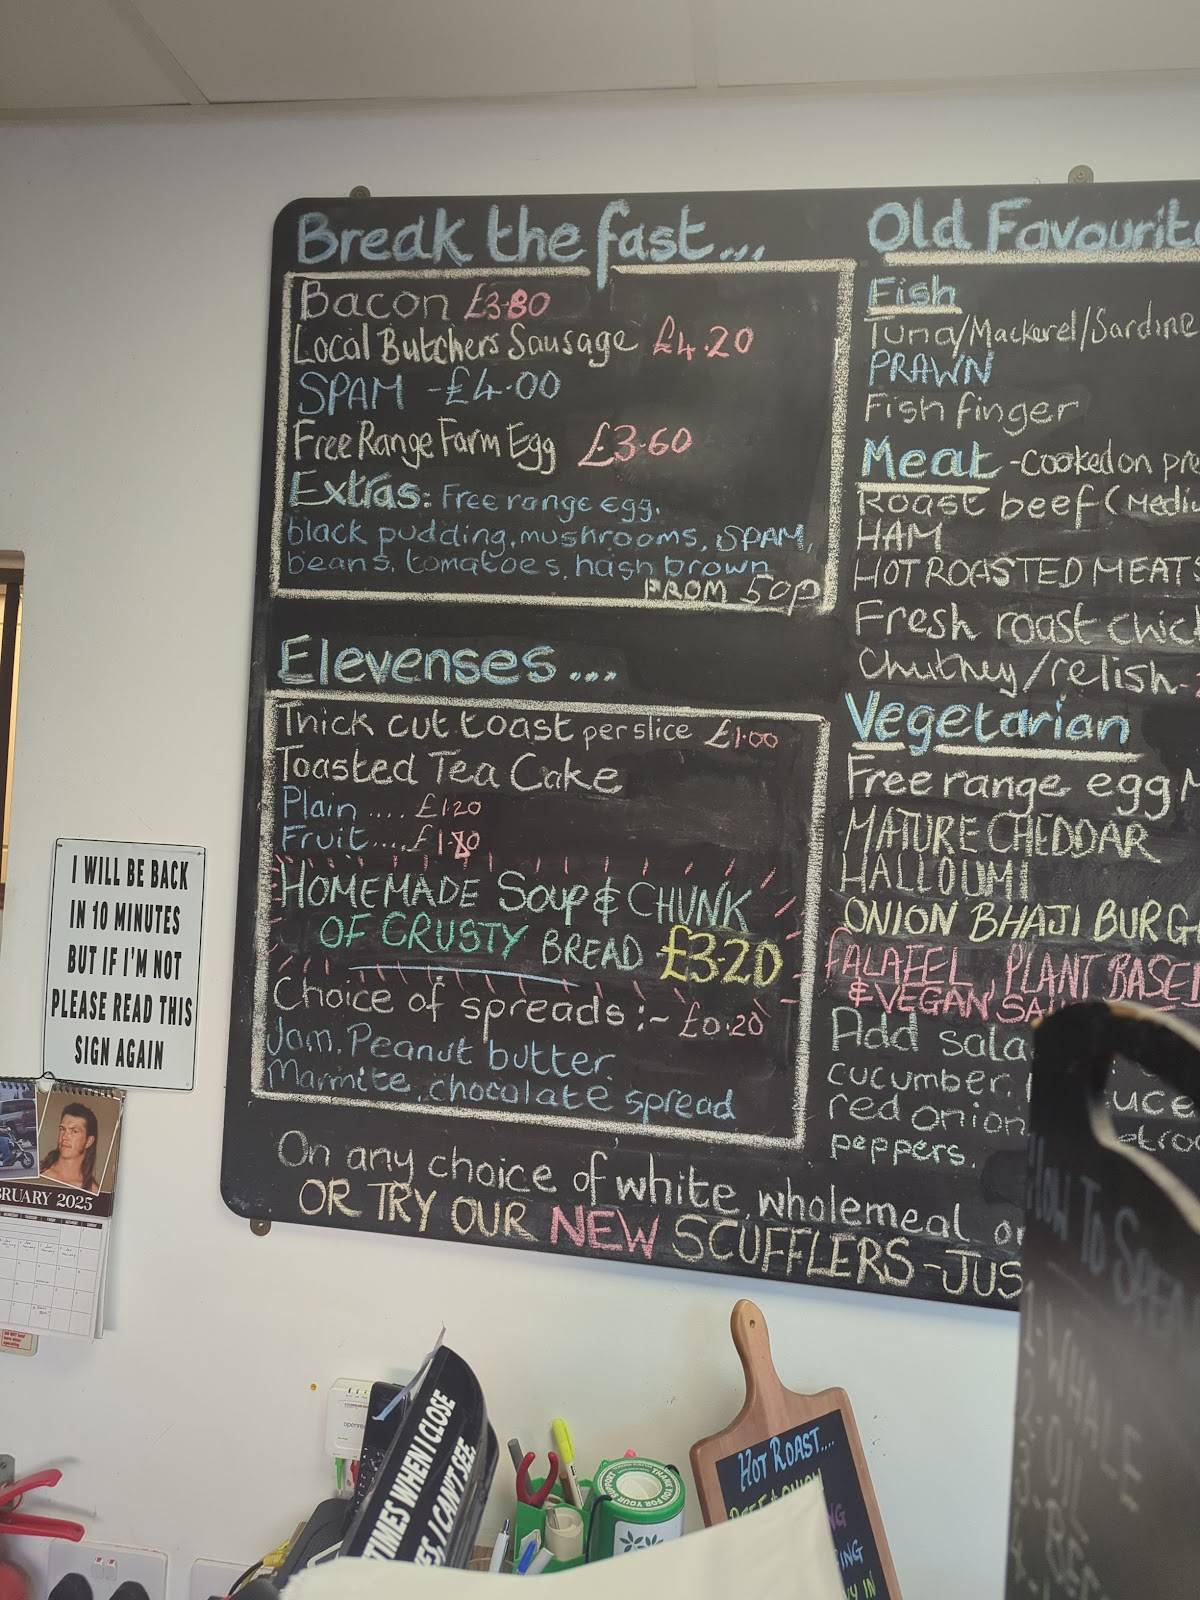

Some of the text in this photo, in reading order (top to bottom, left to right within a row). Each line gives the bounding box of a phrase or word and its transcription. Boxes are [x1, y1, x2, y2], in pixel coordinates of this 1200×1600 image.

[299, 211, 473, 267] Break
[488, 204, 588, 264] the
[867, 197, 972, 252] Old
[301, 279, 448, 320] Bacon
[868, 274, 957, 306] Fish
[294, 322, 370, 364] Local
[377, 322, 499, 365] Butchers
[508, 322, 639, 368] Sausage
[869, 349, 995, 388] PRAWN
[298, 371, 404, 416] SPAM
[864, 391, 1079, 436] Fish finger
[293, 419, 352, 460] Free
[357, 420, 434, 470] Range
[437, 417, 501, 457] Farm
[507, 422, 556, 475] Egg
[862, 435, 1003, 481] Meat
[1118, 453, 1153, 475] on
[290, 469, 432, 508] Extras:
[442, 483, 498, 511] Free
[507, 494, 592, 523] range
[857, 485, 985, 517] Roast
[1002, 484, 1098, 529] beef
[287, 518, 368, 545] black
[857, 518, 943, 553] HAM
[576, 554, 653, 580] hash
[664, 555, 769, 577] brown
[854, 557, 921, 591] HOT
[925, 556, 1083, 588] ROASTED
[644, 573, 820, 616] FROM 50p
[856, 600, 981, 640] Fresh
[998, 602, 1098, 645] roast
[275, 699, 374, 736] Thick
[388, 709, 449, 740] cut
[461, 710, 574, 741] toast
[582, 722, 627, 750] per
[633, 715, 693, 742] slice
[845, 689, 1130, 757] Vegetarian
[276, 744, 624, 794] Toasted Tea Cake
[847, 752, 933, 799] Free
[944, 769, 1071, 817] range
[1086, 772, 1171, 822] egg
[843, 804, 1162, 863] MATURE CHEDDAR
[71, 855, 189, 891] I WILL BE BACK
[841, 853, 1030, 901] HALLOUMI
[69, 899, 181, 936] IN 10 MINUTES
[280, 860, 480, 909] HOMEMADE
[627, 881, 753, 933] CHUNK
[320, 914, 372, 949] OF
[382, 911, 529, 960] CRUSTY
[542, 928, 644, 971] BREAD
[844, 896, 1200, 948] ONION BHAJI BURG
[67, 944, 182, 981] BUT IF I'M NOT
[1004, 943, 1106, 996] PLANT
[51, 988, 193, 1027] PLEASE READ THIS
[273, 976, 394, 1014] Choice
[409, 975, 445, 1022] of
[74, 1035, 165, 1071] SIGN AGAIN
[347, 1022, 473, 1064] Peanut
[832, 1006, 1035, 1062] Add sala
[429, 1073, 614, 1112] chocolate
[624, 1088, 736, 1125] spread
[829, 1093, 899, 1122] red
[0, 1187, 94, 1212] RUARY 2025
[278, 1130, 330, 1168] On
[347, 1146, 414, 1187] any
[428, 1146, 557, 1194] choice
[573, 1150, 608, 1206] of
[758, 1177, 970, 1244] wholemeal
[299, 1178, 362, 1216] OR
[367, 1180, 437, 1232] TRY
[451, 1195, 540, 1243] OUR
[550, 1204, 660, 1260] NEW
[418, 1388, 457, 1445] CLOSE
[412, 1435, 438, 1454] I
[389, 1447, 434, 1509] WHEN
[738, 1448, 767, 1492] HOT
[432, 1464, 465, 1534] CAN'T
